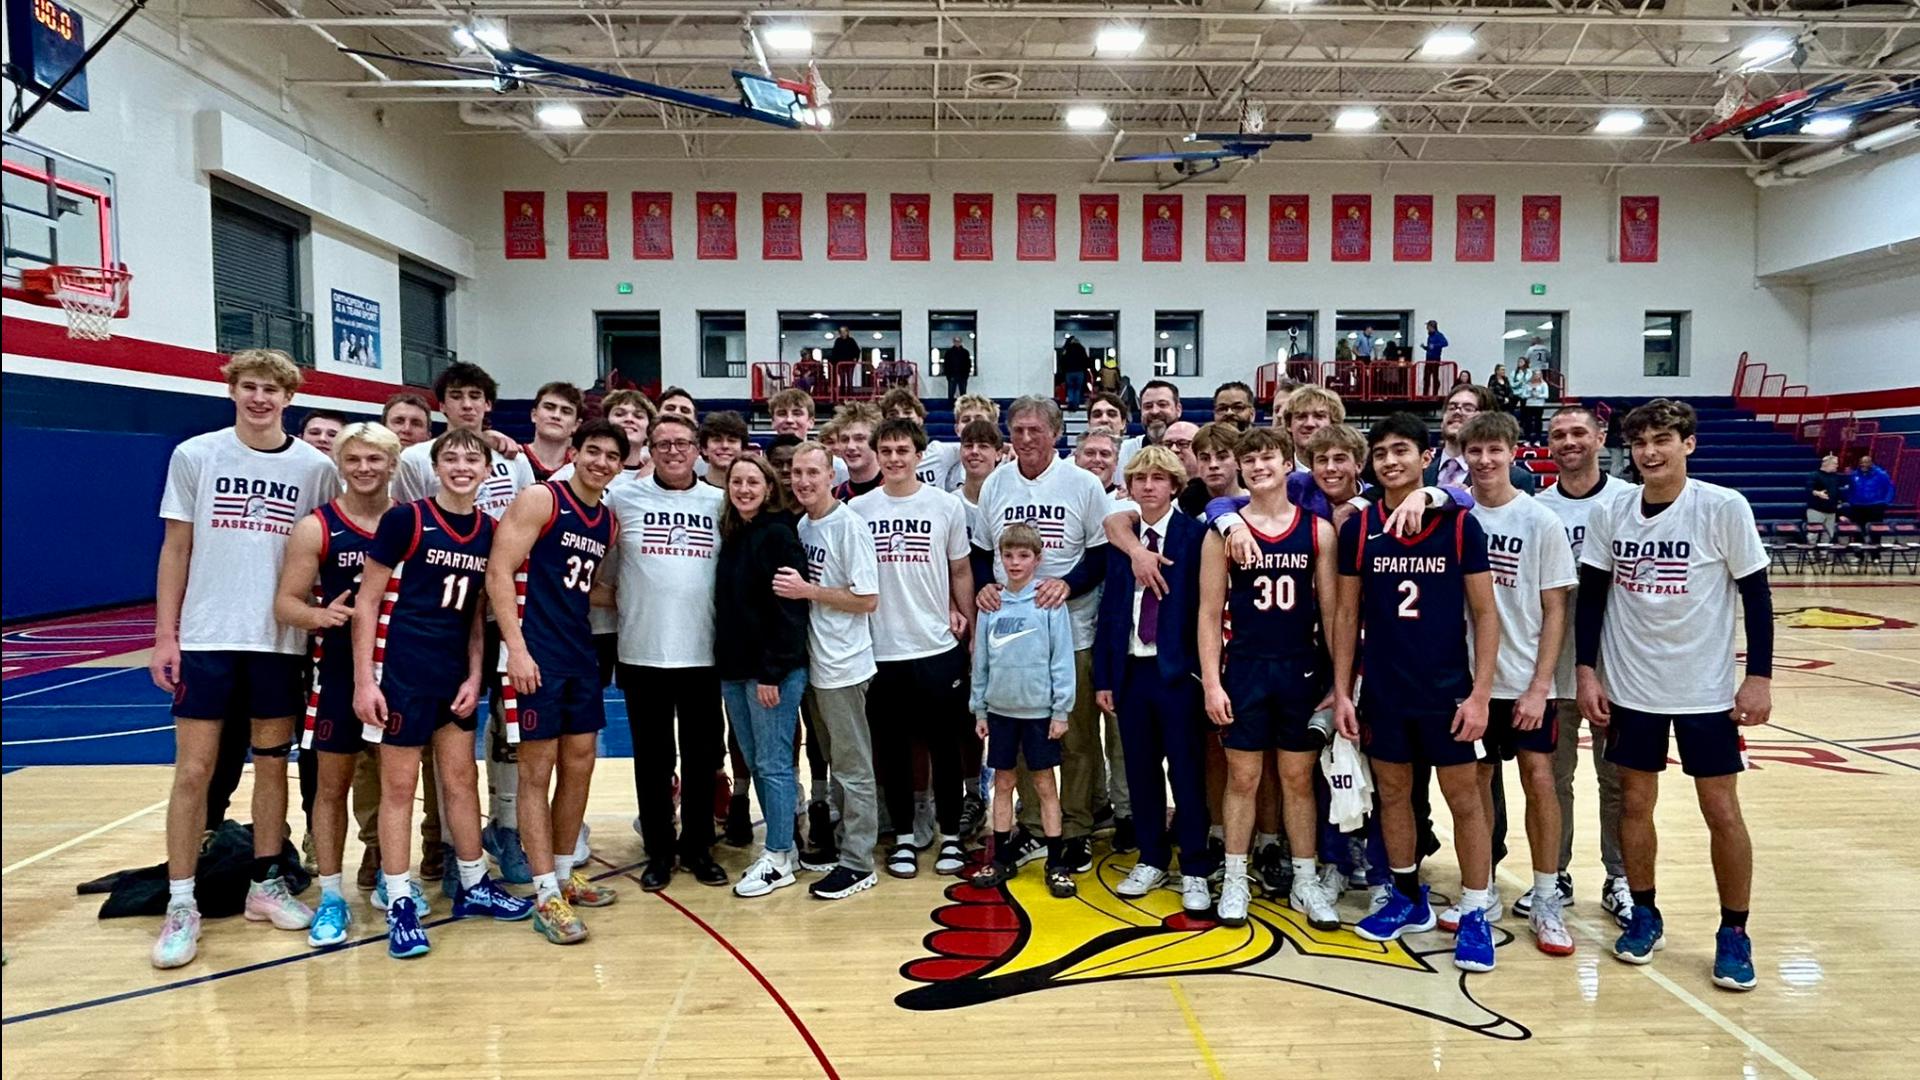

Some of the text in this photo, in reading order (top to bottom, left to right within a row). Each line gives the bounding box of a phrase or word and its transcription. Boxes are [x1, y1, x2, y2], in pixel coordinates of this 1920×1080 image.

[346, 306, 361, 317] TEAM
[361, 310, 378, 321] SPORT
[366, 301, 378, 314] CARE
[216, 477, 299, 502] ORONO
[644, 512, 713, 530] ORONO
[1005, 505, 1065, 520] ORONO
[211, 519, 292, 536] BASKETBALL
[868, 519, 931, 534] ORONO
[561, 532, 606, 558] SPARTANS
[641, 546, 712, 559] BASKETBALL
[1485, 533, 1523, 554] NO
[1612, 540, 1690, 559] ORONO
[338, 551, 365, 567] SPA
[425, 549, 488, 572] SPARTANS
[1373, 557, 1446, 573] SPARTANS
[563, 555, 595, 593] 33
[441, 574, 469, 611] 11
[1253, 574, 1295, 610] 30
[1398, 580, 1419, 618] 2
[994, 617, 1027, 634] NIKE
